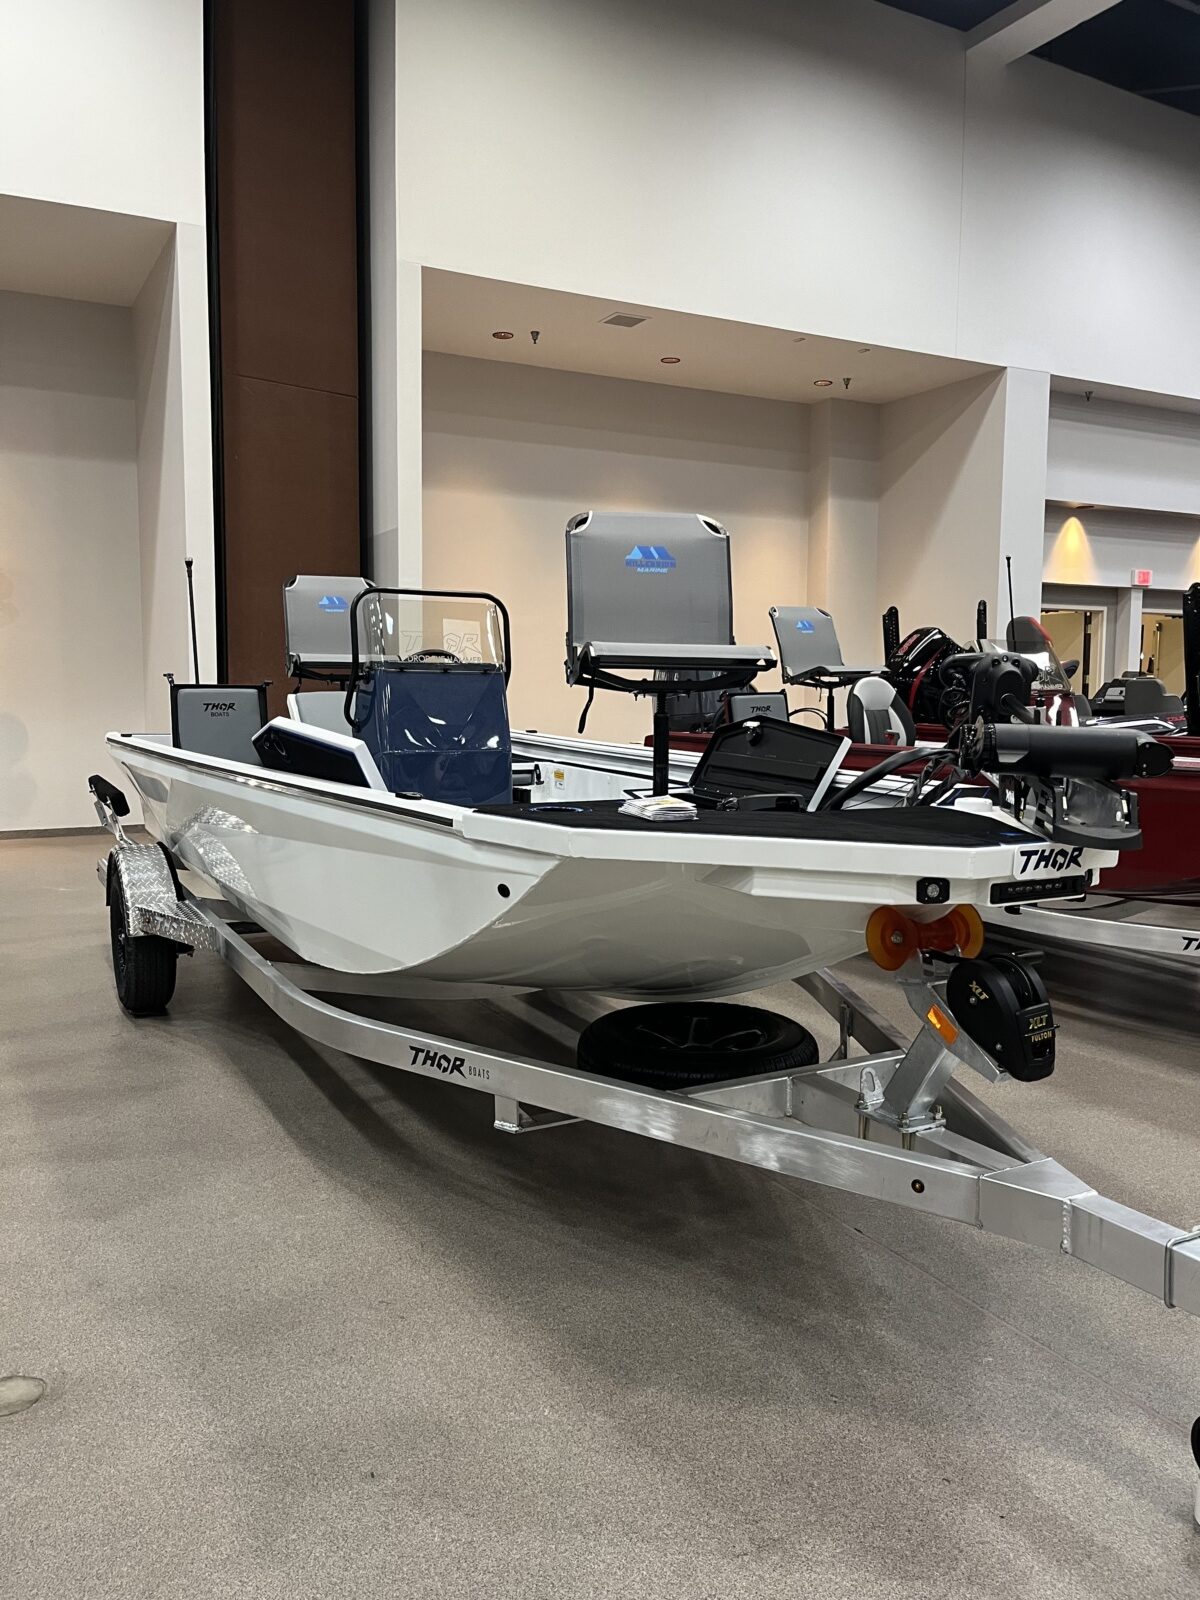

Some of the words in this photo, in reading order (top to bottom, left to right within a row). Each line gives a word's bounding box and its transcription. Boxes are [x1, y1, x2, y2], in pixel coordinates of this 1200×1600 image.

[203, 702, 237, 712] THOR
[749, 705, 773, 714] THOR
[1019, 847, 1084, 875] THOR
[969, 979, 990, 1001] XLT
[1028, 1013, 1049, 1030] XLT
[1031, 1030, 1054, 1044] FULTON
[409, 1044, 468, 1080] THOR
[468, 1065, 490, 1081] BOATS
